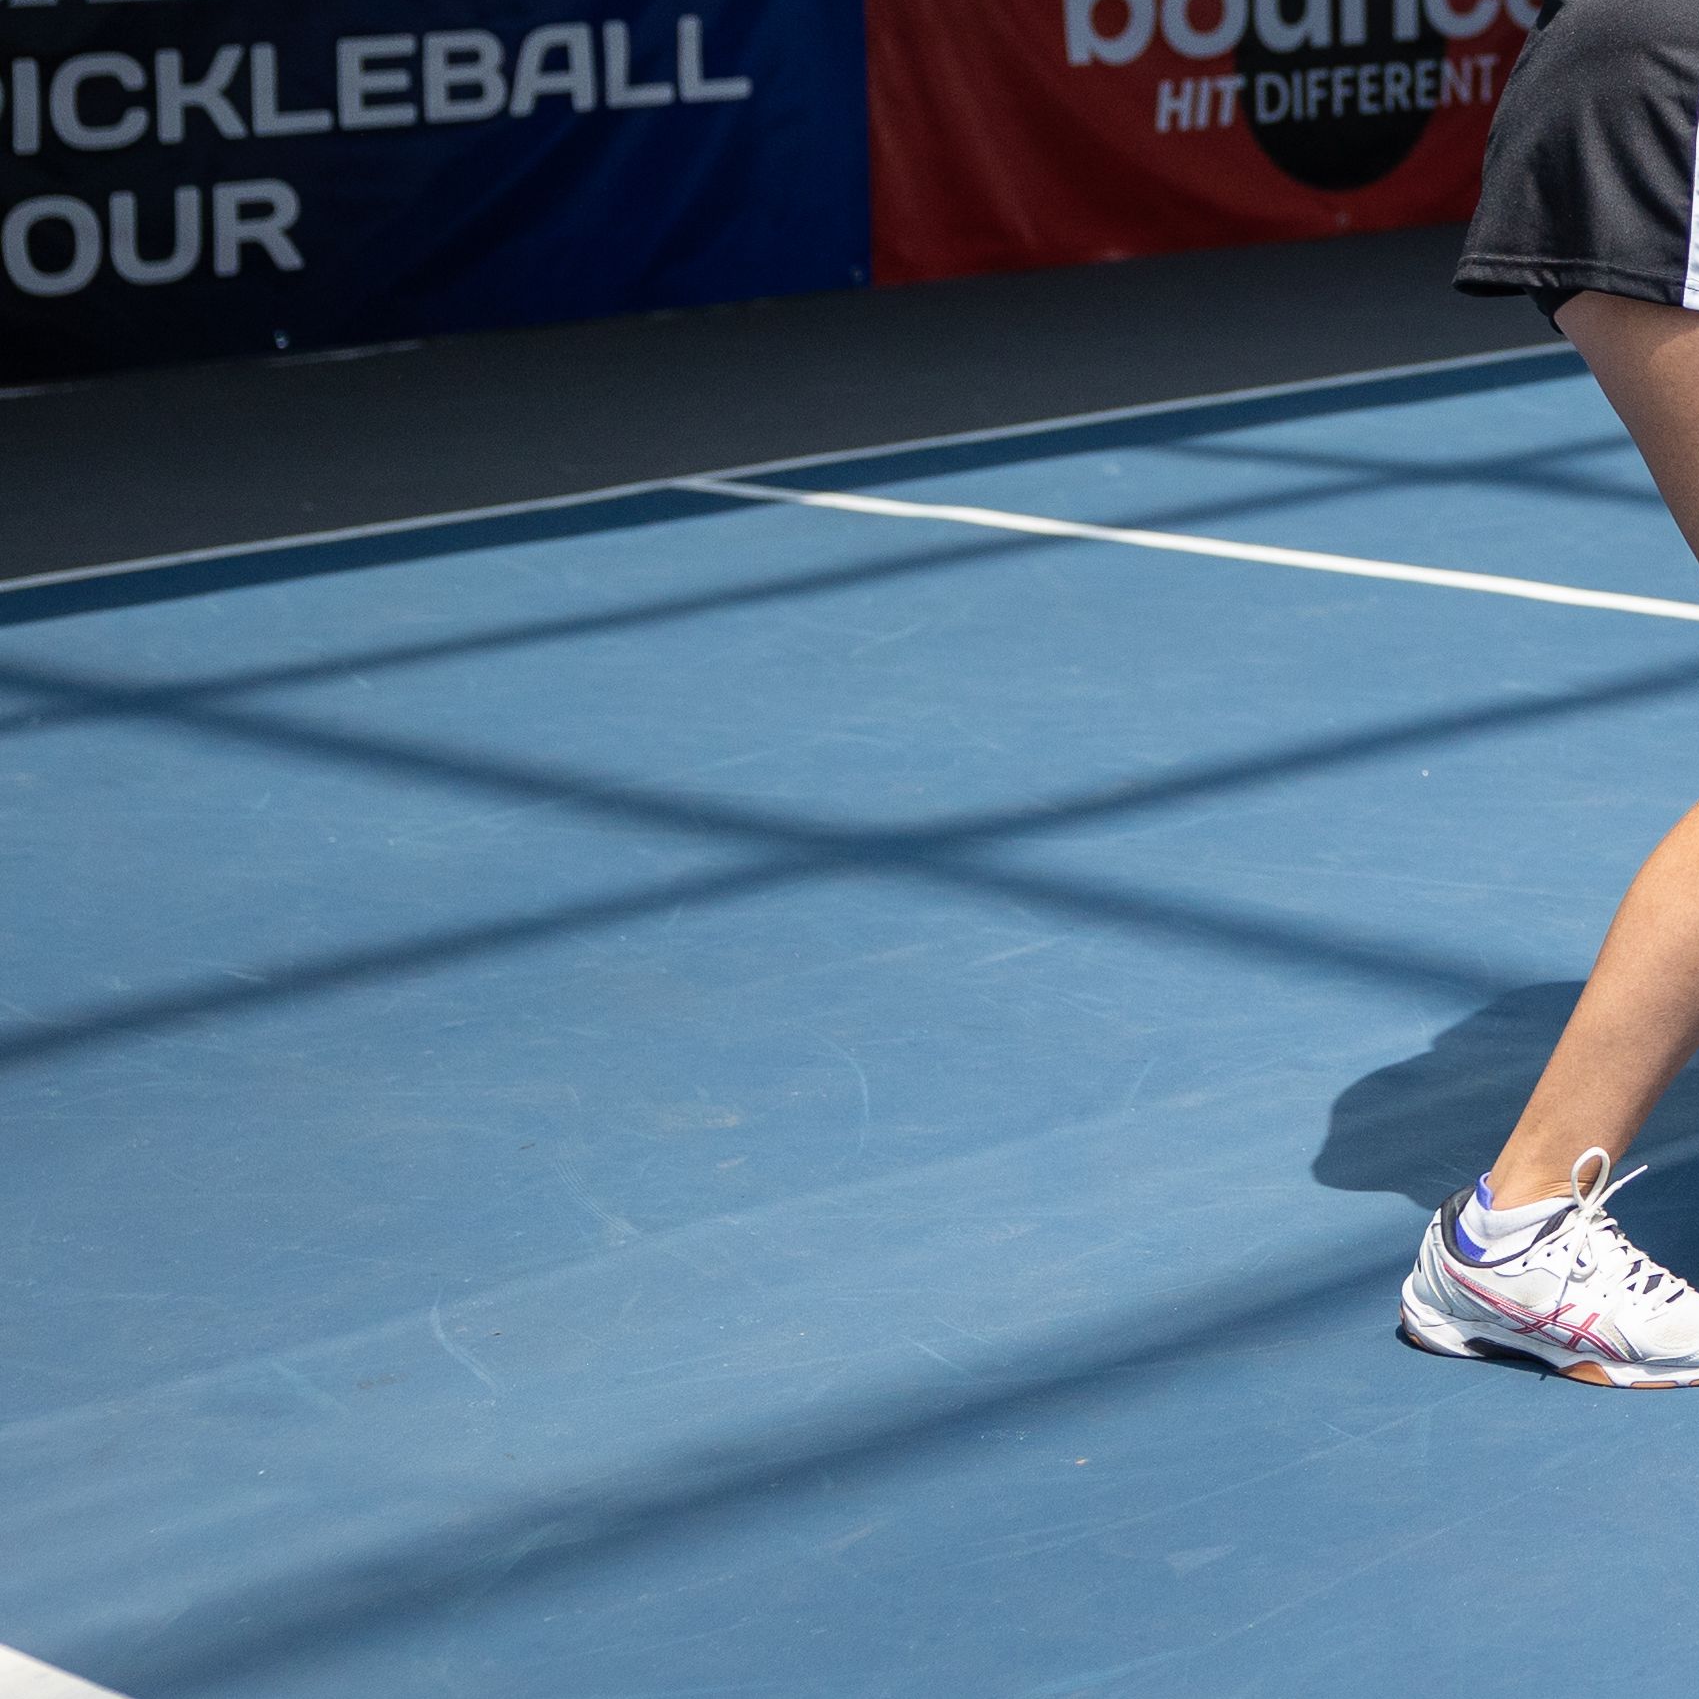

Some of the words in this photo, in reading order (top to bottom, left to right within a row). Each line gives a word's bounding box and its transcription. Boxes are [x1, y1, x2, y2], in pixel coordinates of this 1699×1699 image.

[0, 13, 753, 156] ICKLEBALL
[1155, 74, 1246, 133] HIT
[1254, 54, 1498, 126] DIFFERENT
[1, 177, 306, 298] OUR
